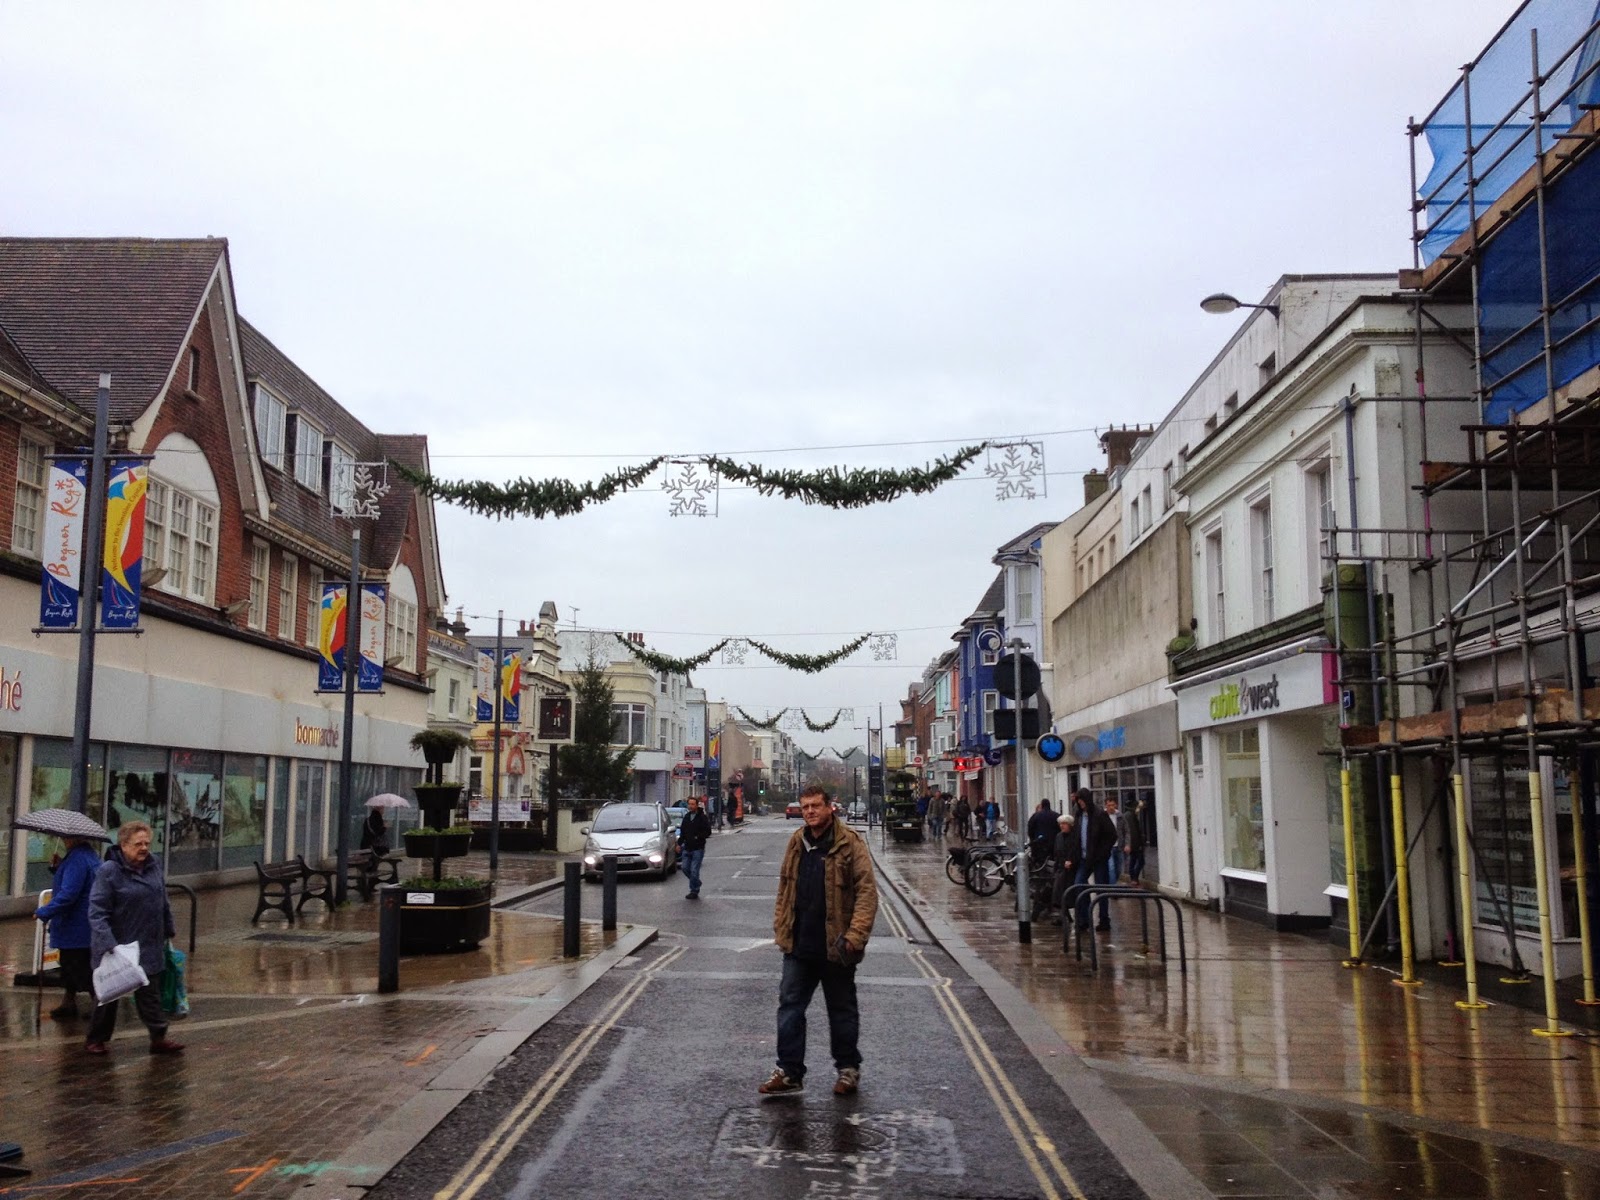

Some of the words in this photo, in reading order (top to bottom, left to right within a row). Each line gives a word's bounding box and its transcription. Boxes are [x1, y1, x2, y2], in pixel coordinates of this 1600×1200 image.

[51, 478, 81, 517] Regis
[47, 523, 77, 577] Bognor
[1249, 673, 1280, 712] west
[295, 716, 339, 748] bonmarché
